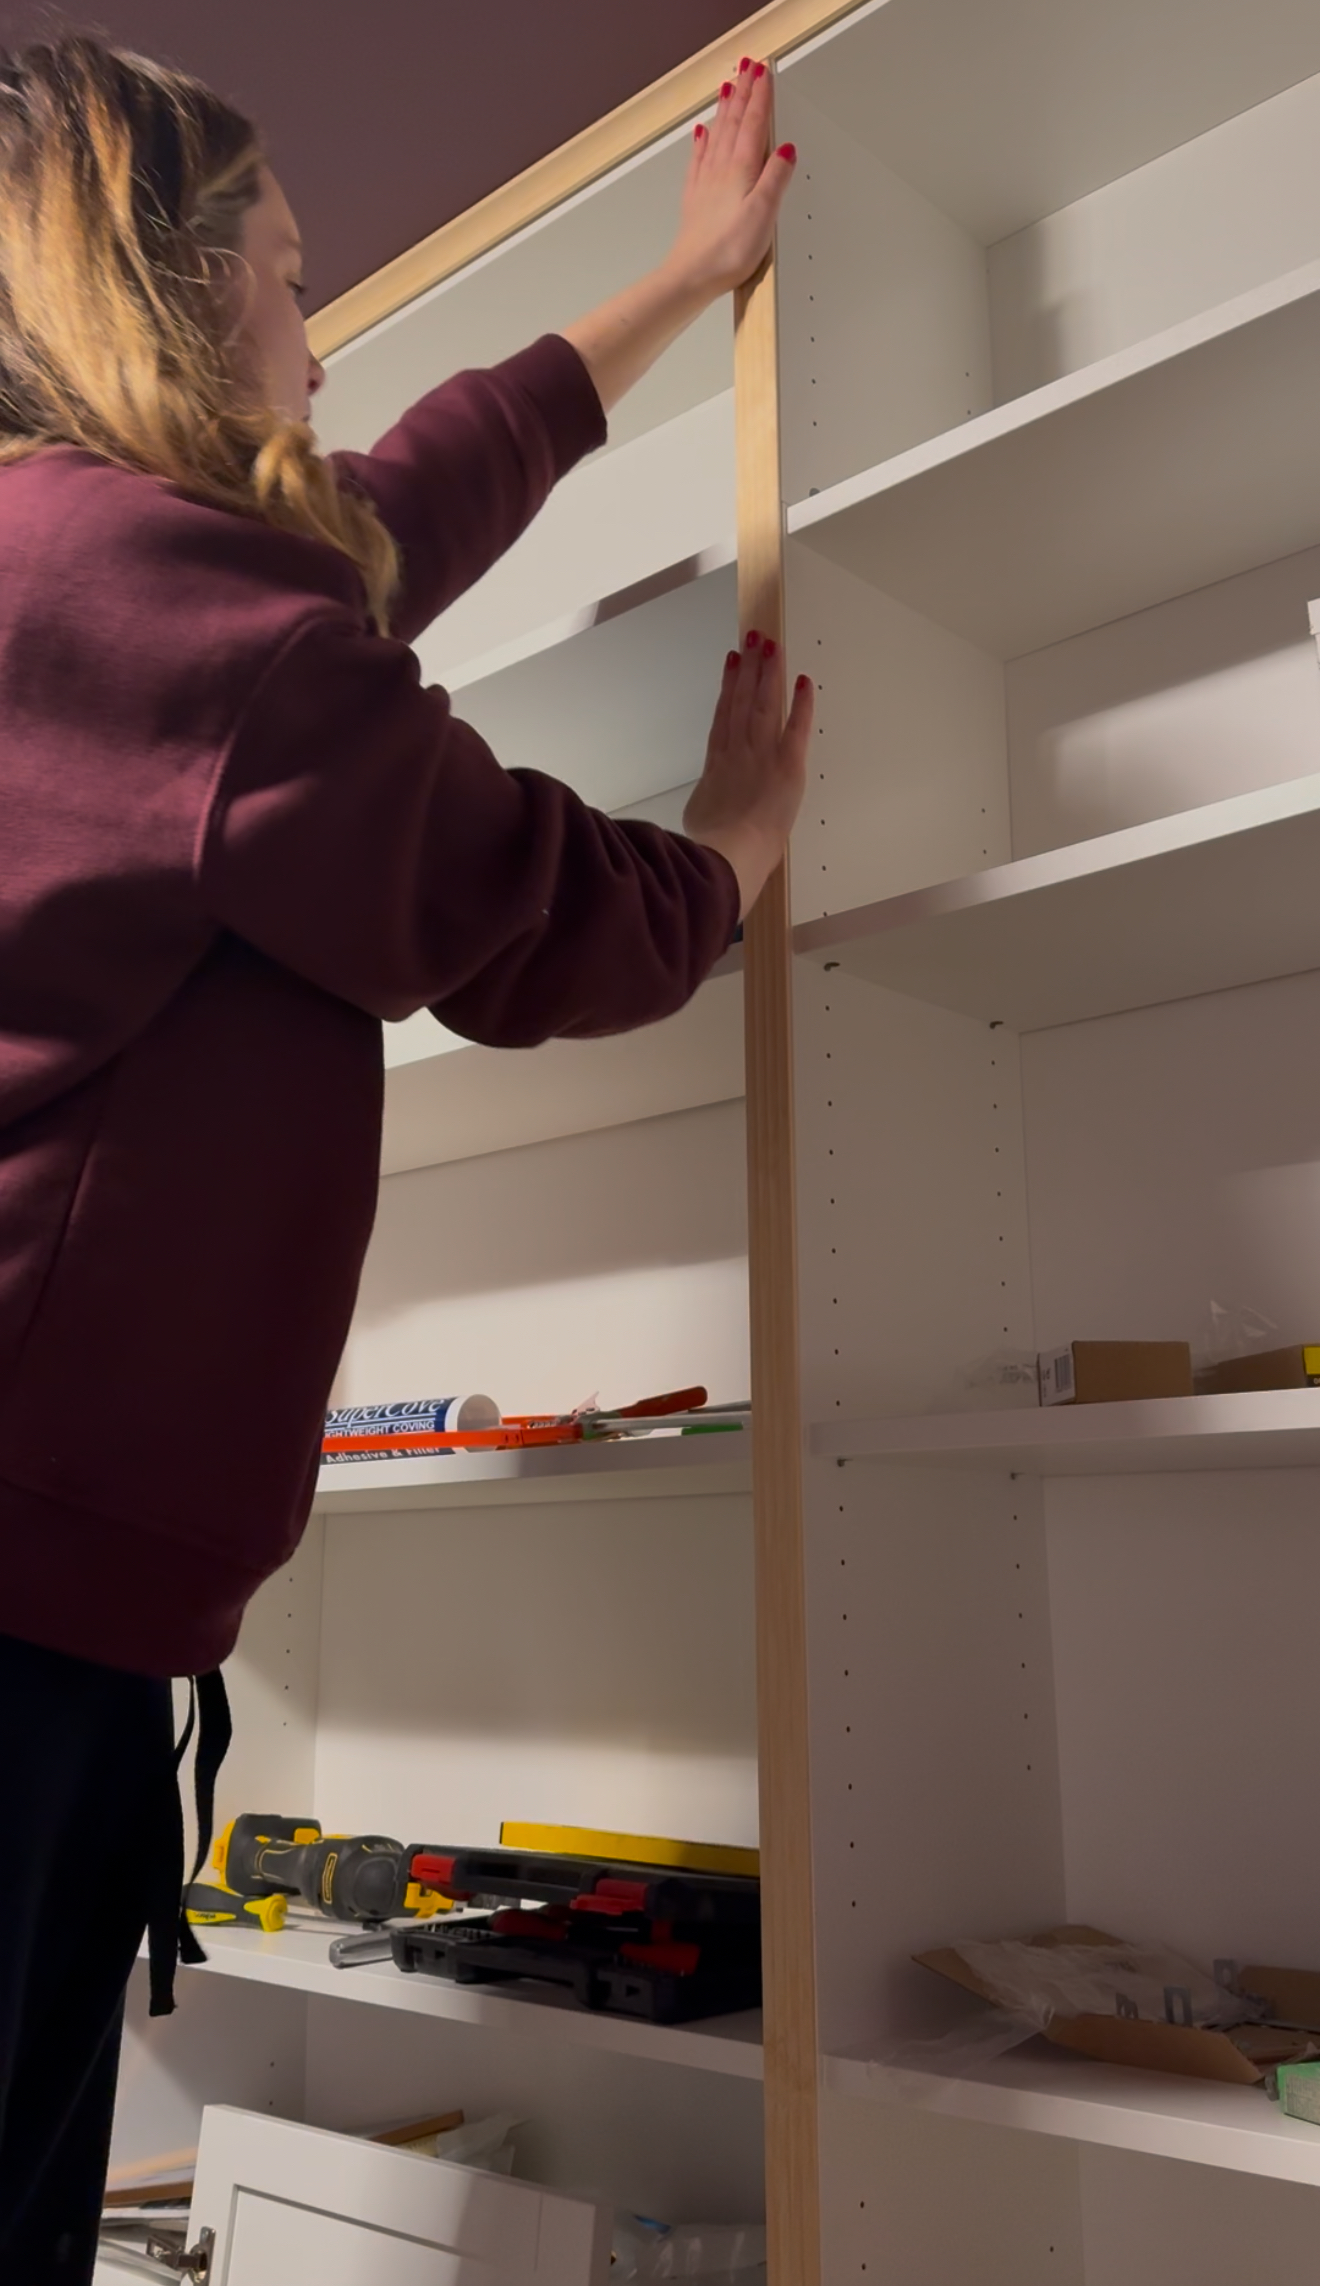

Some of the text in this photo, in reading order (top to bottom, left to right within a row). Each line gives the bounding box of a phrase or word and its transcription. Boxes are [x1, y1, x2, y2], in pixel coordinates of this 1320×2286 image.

[325, 1420, 435, 1438] IGHTWEIGHT COVING
[326, 1447, 440, 1463] Adhesive & Filler
